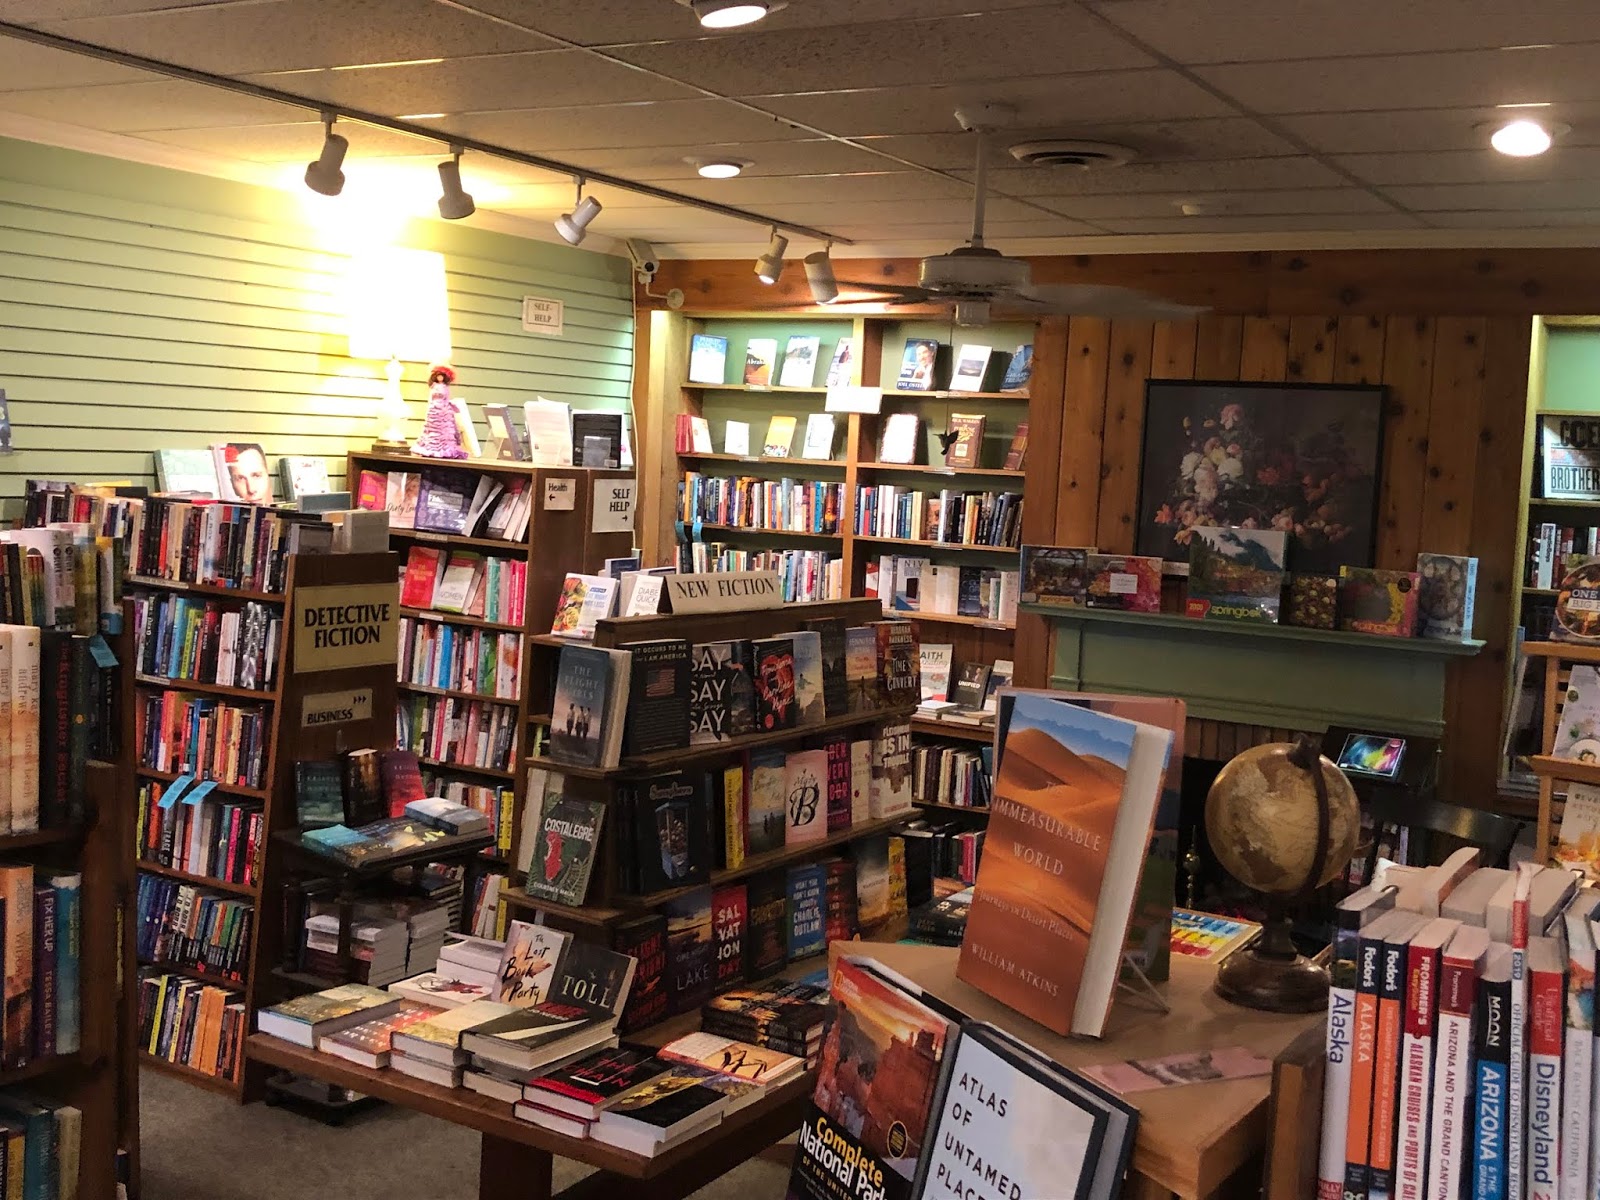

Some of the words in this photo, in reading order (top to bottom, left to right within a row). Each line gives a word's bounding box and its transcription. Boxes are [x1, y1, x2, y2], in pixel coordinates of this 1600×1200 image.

[534, 314, 552, 323] HELP
[548, 482, 568, 493] Health
[612, 488, 631, 500] SELF
[609, 501, 631, 512] HELP
[904, 559, 924, 567] NIV
[676, 579, 710, 599] NEW
[718, 577, 775, 598] FICTION
[1572, 589, 1599, 599] ONE
[304, 603, 390, 628] DETECTIVE
[1572, 599, 1592, 609] BIG
[314, 625, 381, 649] FICTION
[659, 652, 687, 660] AMERICA
[307, 708, 353, 725] BUSINESS
[789, 783, 820, 827] B
[544, 817, 595, 843] COSTALEGRE
[994, 797, 1102, 852] IMMEASURABLE
[1012, 841, 1064, 877] WORLD
[44, 897, 53, 914] FIX
[717, 904, 741, 924] SAL
[43, 915, 53, 936] HER
[717, 922, 741, 942] VAT
[44, 937, 53, 952] UP
[524, 940, 551, 961] Lost
[501, 956, 533, 984] Book
[676, 963, 710, 991] LAKE
[971, 943, 1015, 976] WILLIAM
[1018, 966, 1059, 998] ATKINS
[1362, 946, 1377, 988] Fodor's
[1385, 950, 1400, 992] Fodor's
[1513, 953, 1523, 980] 2019
[44, 970, 52, 1000] TESSA
[508, 981, 541, 1005] Party
[560, 974, 611, 1009] TOLL
[1417, 955, 1431, 1026] FROMMER'S
[43, 1002, 52, 1035] BAILEY
[1328, 993, 1352, 1064] Alaska
[1357, 1002, 1374, 1063] ALASKA
[1487, 995, 1502, 1047] MOON
[1511, 1003, 1522, 1048] OFFICIAL
[1447, 1020, 1459, 1066] ARIZONA
[1409, 1043, 1424, 1083] ALASKAN
[1511, 1051, 1521, 1085] GUIDE
[959, 1072, 1008, 1118] ATLAS
[1445, 1070, 1455, 1093] AND
[1511, 1088, 1520, 1101] TO
[952, 1102, 973, 1127] OF
[1406, 1084, 1422, 1123] CRUISES
[1443, 1095, 1454, 1116] THE
[1479, 1066, 1501, 1160] ARIZONA
[1407, 1124, 1417, 1138] AND
[1510, 1103, 1520, 1170] DISNEYLAND
[1530, 1062, 1556, 1184] Disneyland
[1440, 1119, 1453, 1156] GRAND
[1568, 1110, 1580, 1178] CALIFORNIA
[799, 1120, 855, 1189] National
[816, 1116, 883, 1189] Complete
[945, 1131, 1022, 1200] UNTAMED
[1403, 1139, 1419, 1169] PORTS
[812, 1163, 825, 1180] THE
[1402, 1170, 1417, 1182] OF
[1487, 1174, 1497, 1193] THE
